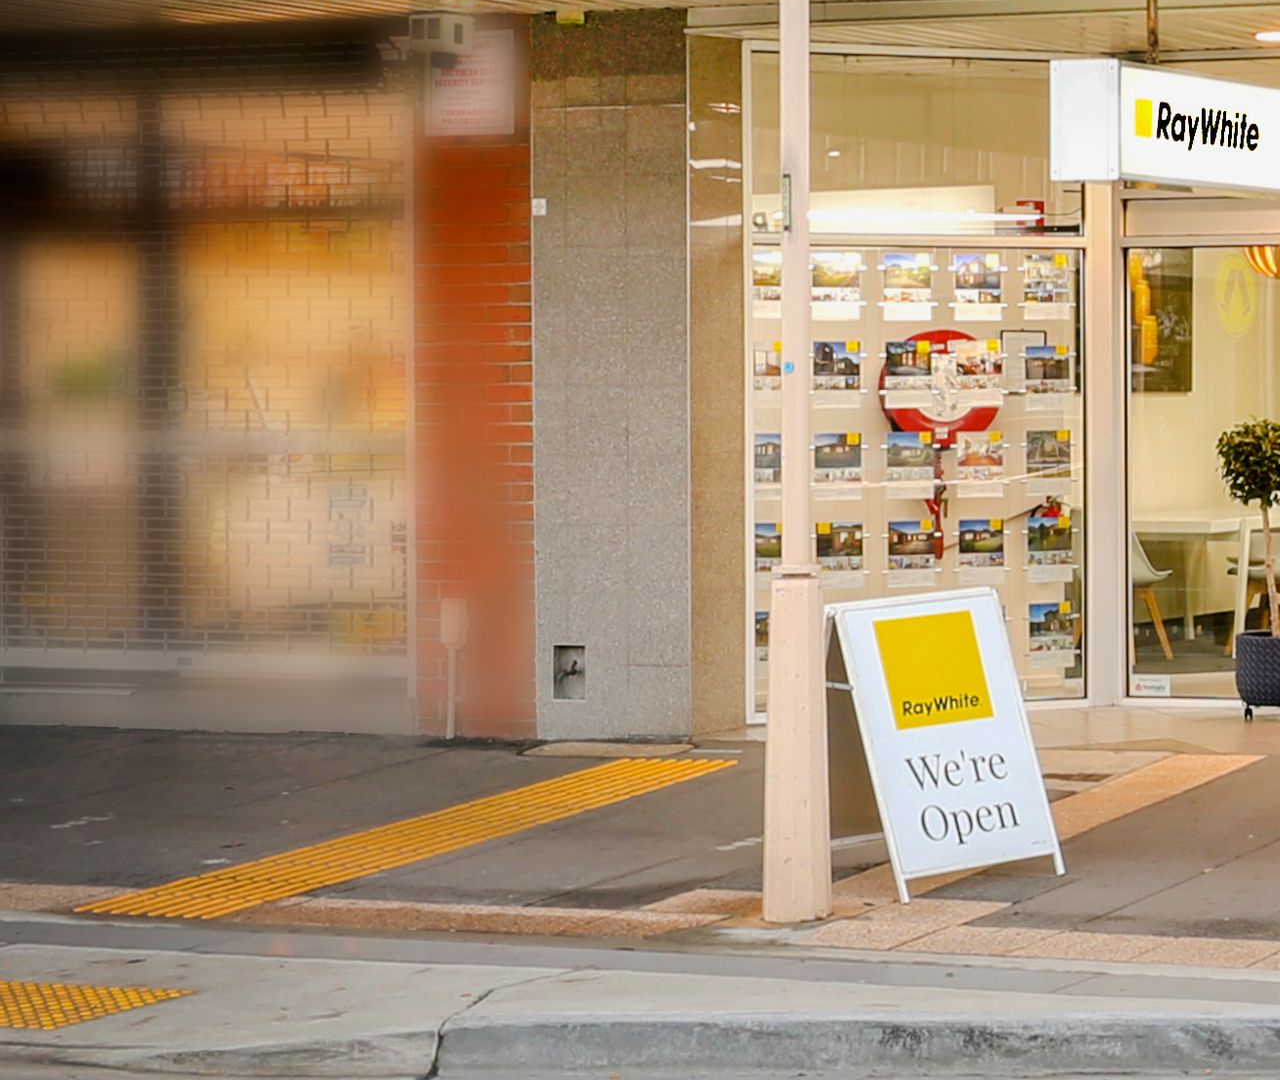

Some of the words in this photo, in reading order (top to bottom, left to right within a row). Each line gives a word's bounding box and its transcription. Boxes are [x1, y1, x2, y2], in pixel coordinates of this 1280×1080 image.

[1157, 101, 1260, 151] RayWhite
[903, 694, 979, 715] RayWhite
[905, 750, 1008, 791] We're
[921, 803, 1020, 844] Open
